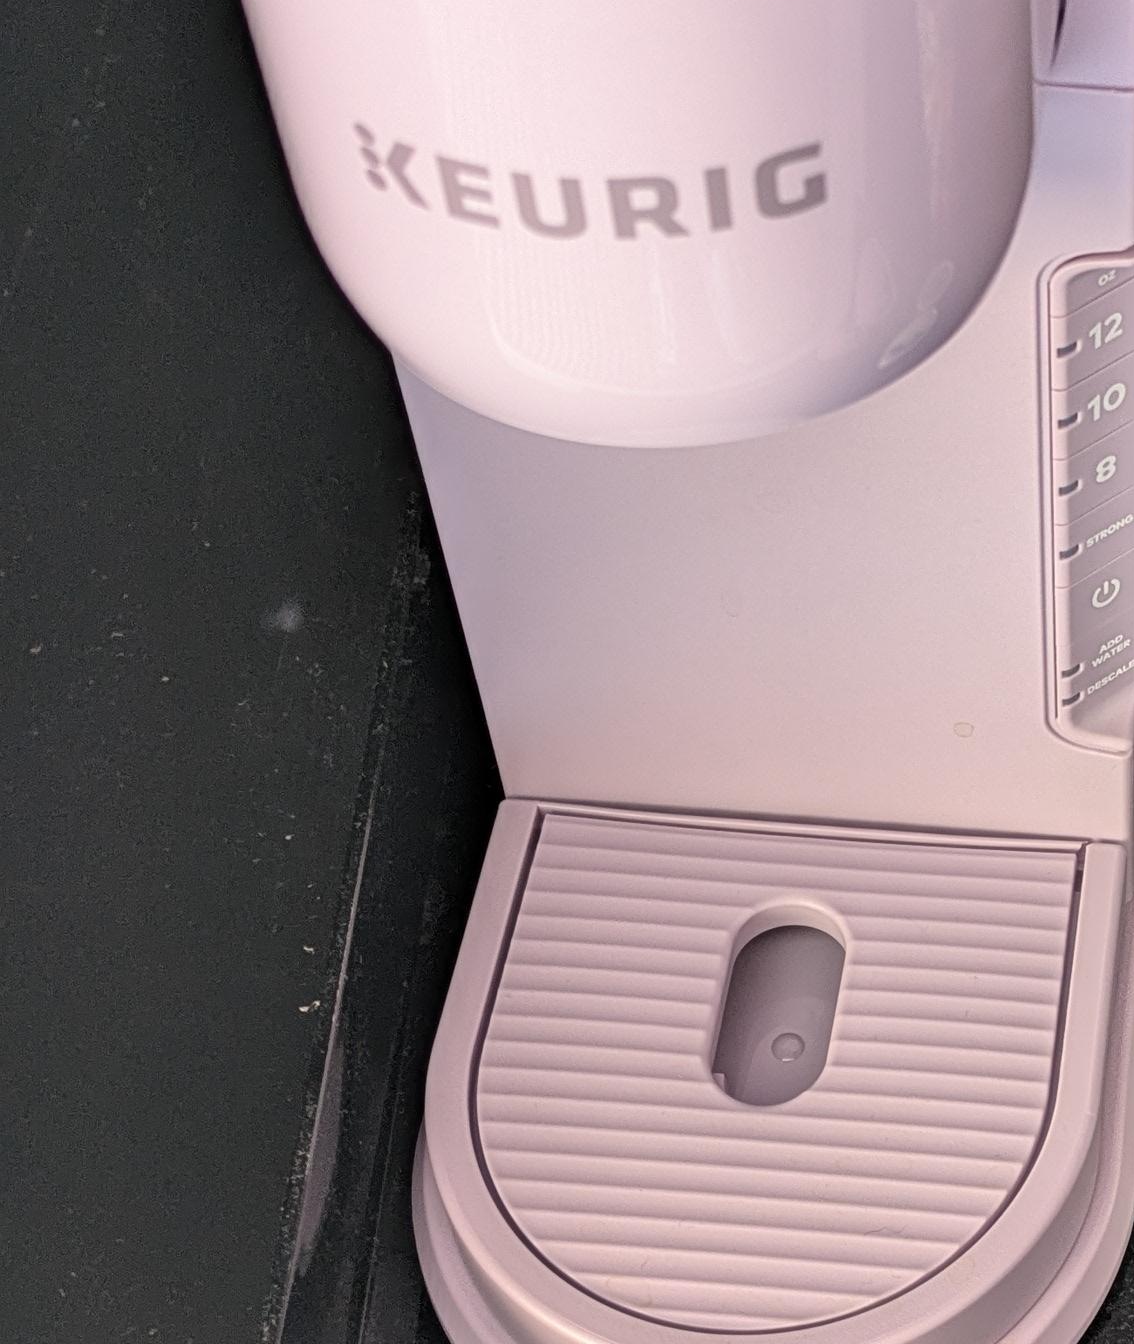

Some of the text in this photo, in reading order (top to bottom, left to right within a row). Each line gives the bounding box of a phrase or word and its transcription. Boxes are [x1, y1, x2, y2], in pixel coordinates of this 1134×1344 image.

[353, 121, 828, 242] KEURIG
[1089, 312, 1123, 349] 12
[1087, 383, 1126, 421] 10
[1096, 455, 1117, 483] 8
[1086, 514, 1134, 548] STRONG
[1091, 638, 1131, 668] WATER
[1098, 634, 1124, 654] ADD
